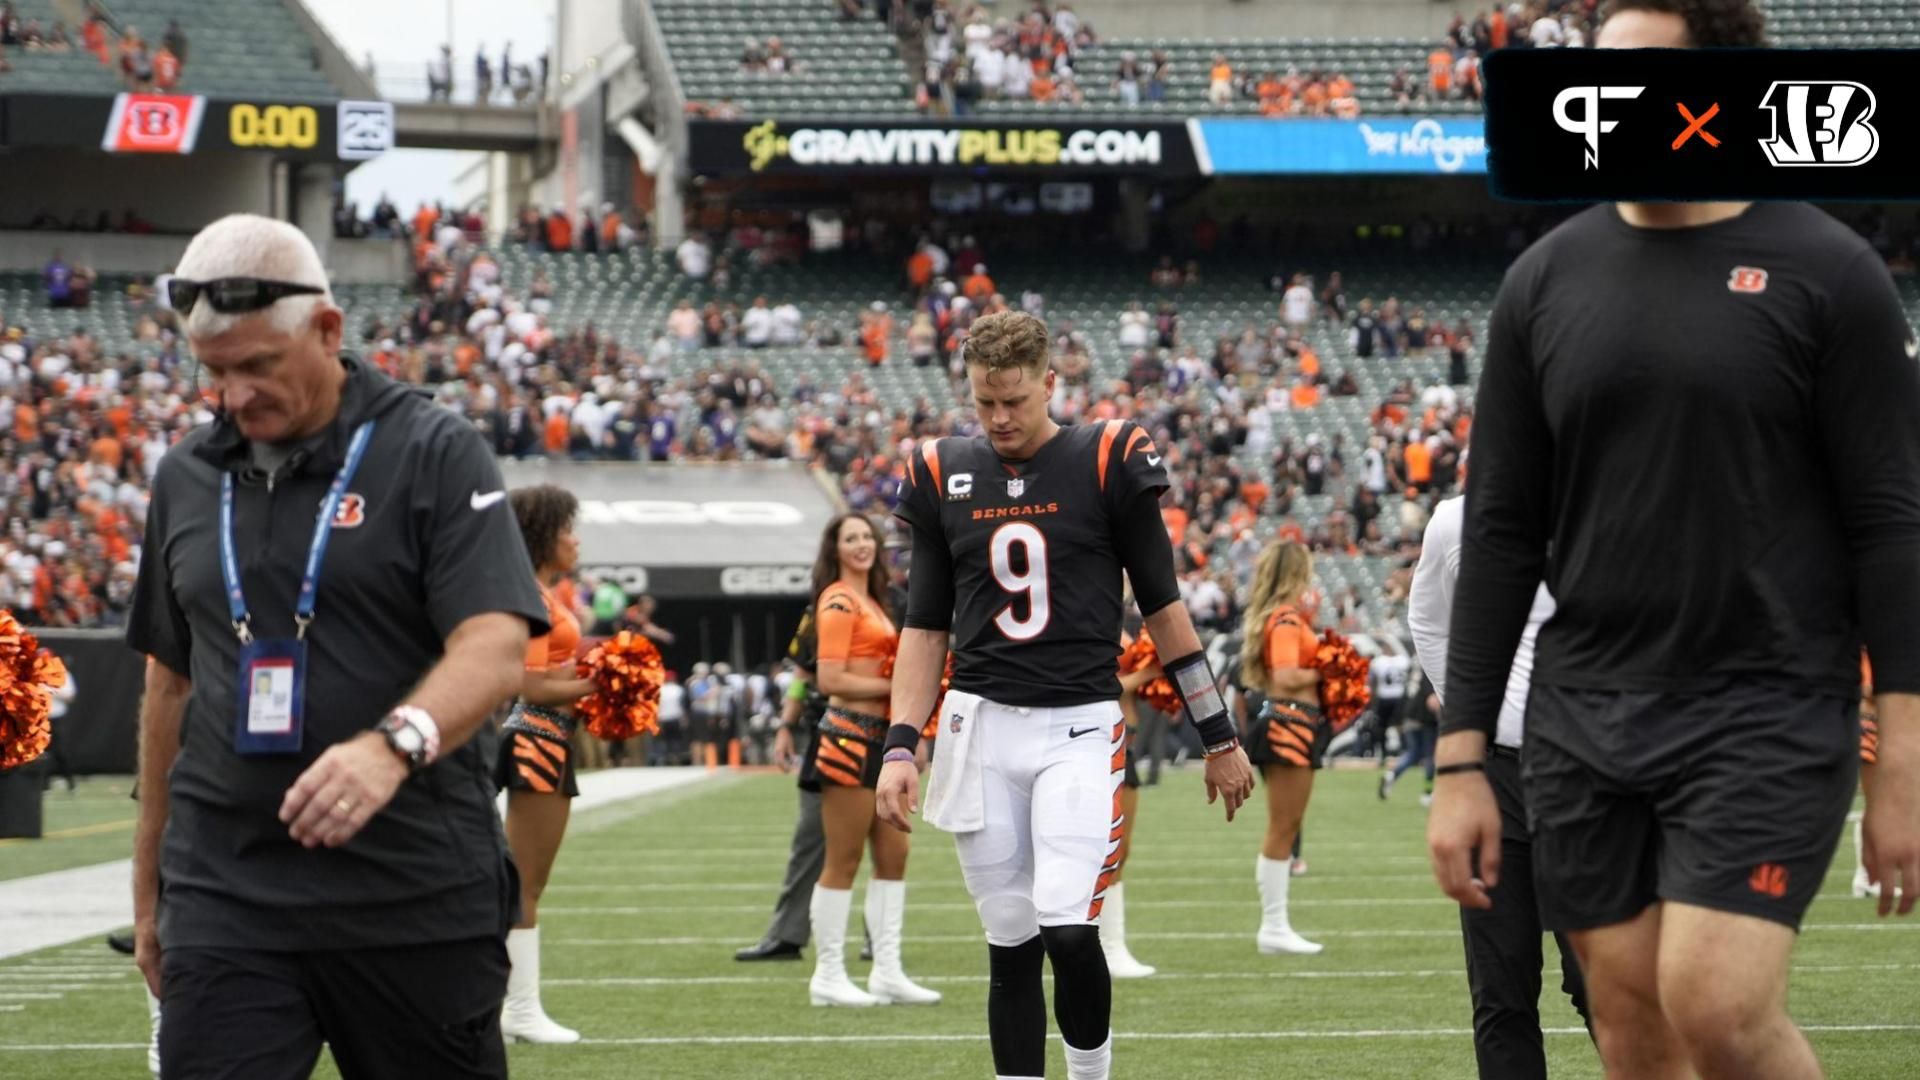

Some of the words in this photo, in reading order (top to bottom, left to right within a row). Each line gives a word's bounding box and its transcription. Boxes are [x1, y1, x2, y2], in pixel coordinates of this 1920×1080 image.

[229, 103, 317, 148] 0:00
[788, 129, 1161, 164] GRAVITYPLUS.COM
[947, 473, 972, 495] C
[972, 502, 1058, 520] BENGALS
[720, 566, 814, 596] GEIC
[988, 521, 1049, 641] 9
